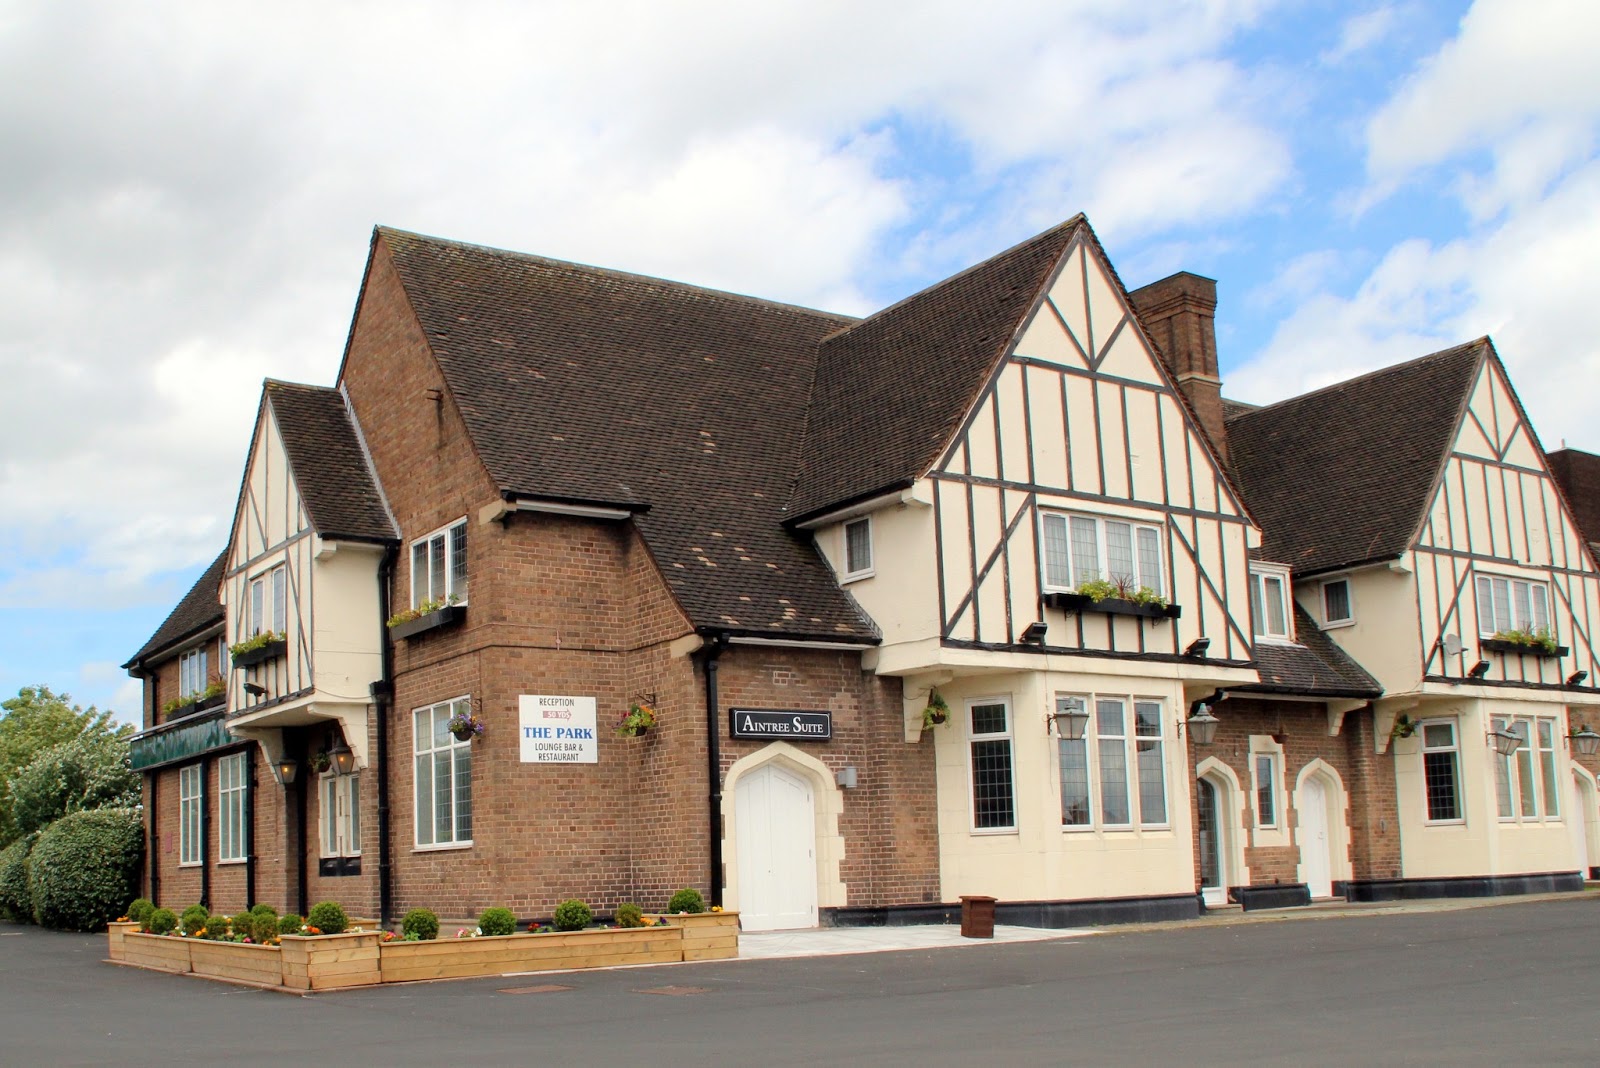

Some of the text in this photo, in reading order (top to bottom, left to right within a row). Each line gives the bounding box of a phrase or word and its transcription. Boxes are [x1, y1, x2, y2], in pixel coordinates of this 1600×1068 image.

[539, 698, 575, 706] RECEPTION
[557, 711, 570, 719] YDS
[524, 727, 593, 739] THE PARK
[535, 743, 562, 751] LOUNGE
[538, 753, 579, 761] RESTAURANT
